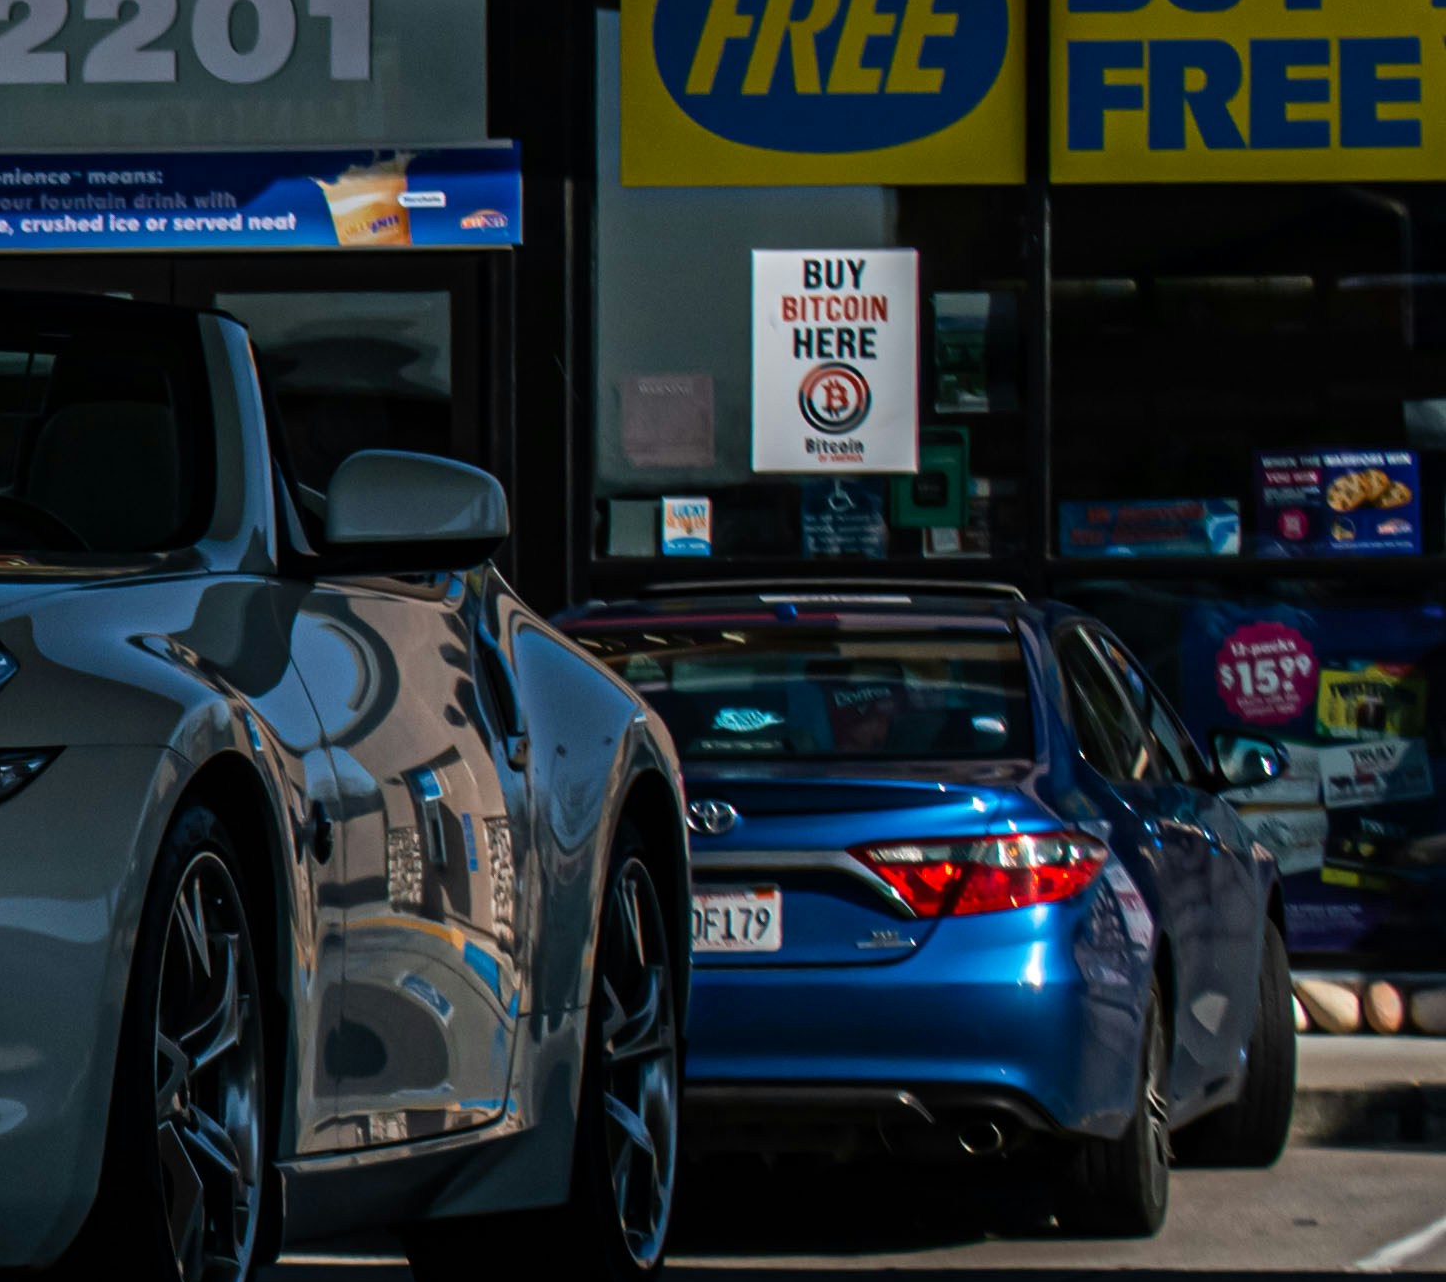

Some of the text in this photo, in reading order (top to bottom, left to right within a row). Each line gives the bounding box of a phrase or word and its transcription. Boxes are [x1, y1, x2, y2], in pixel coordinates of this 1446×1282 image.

[1067, 37, 1421, 150] FREE
[87, 170, 165, 185] means:
[39, 192, 127, 211] fountain
[133, 190, 189, 210] drink
[193, 189, 239, 210] with
[20, 213, 105, 234] crushed
[108, 212, 141, 233] ice
[145, 217, 169, 233] or
[172, 212, 244, 233] served
[247, 211, 298, 232] neat
[803, 258, 866, 290] BUY
[781, 294, 889, 323] BITCOIN
[793, 327, 877, 359] HERE
[805, 437, 865, 455] Bitcoin
